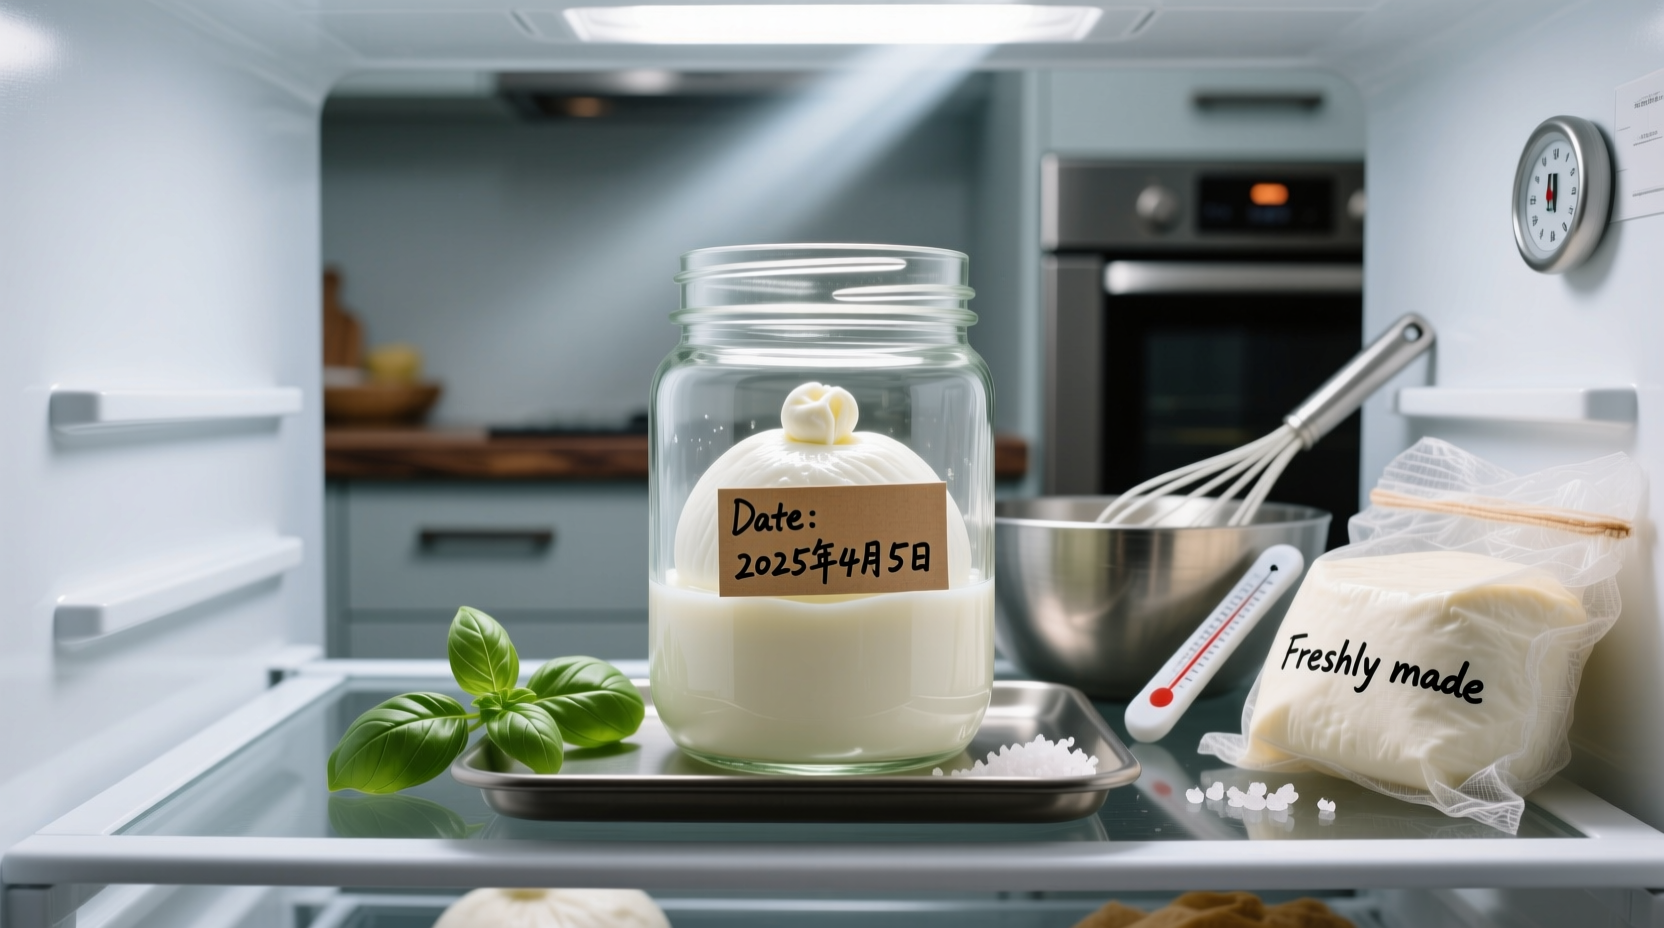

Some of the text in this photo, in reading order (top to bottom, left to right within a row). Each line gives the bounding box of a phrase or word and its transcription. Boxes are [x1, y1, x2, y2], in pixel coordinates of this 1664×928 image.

[732, 498, 816, 536] Date:
[734, 538, 931, 585] 2025年4月5日
[1281, 633, 1484, 704] Freshly made
